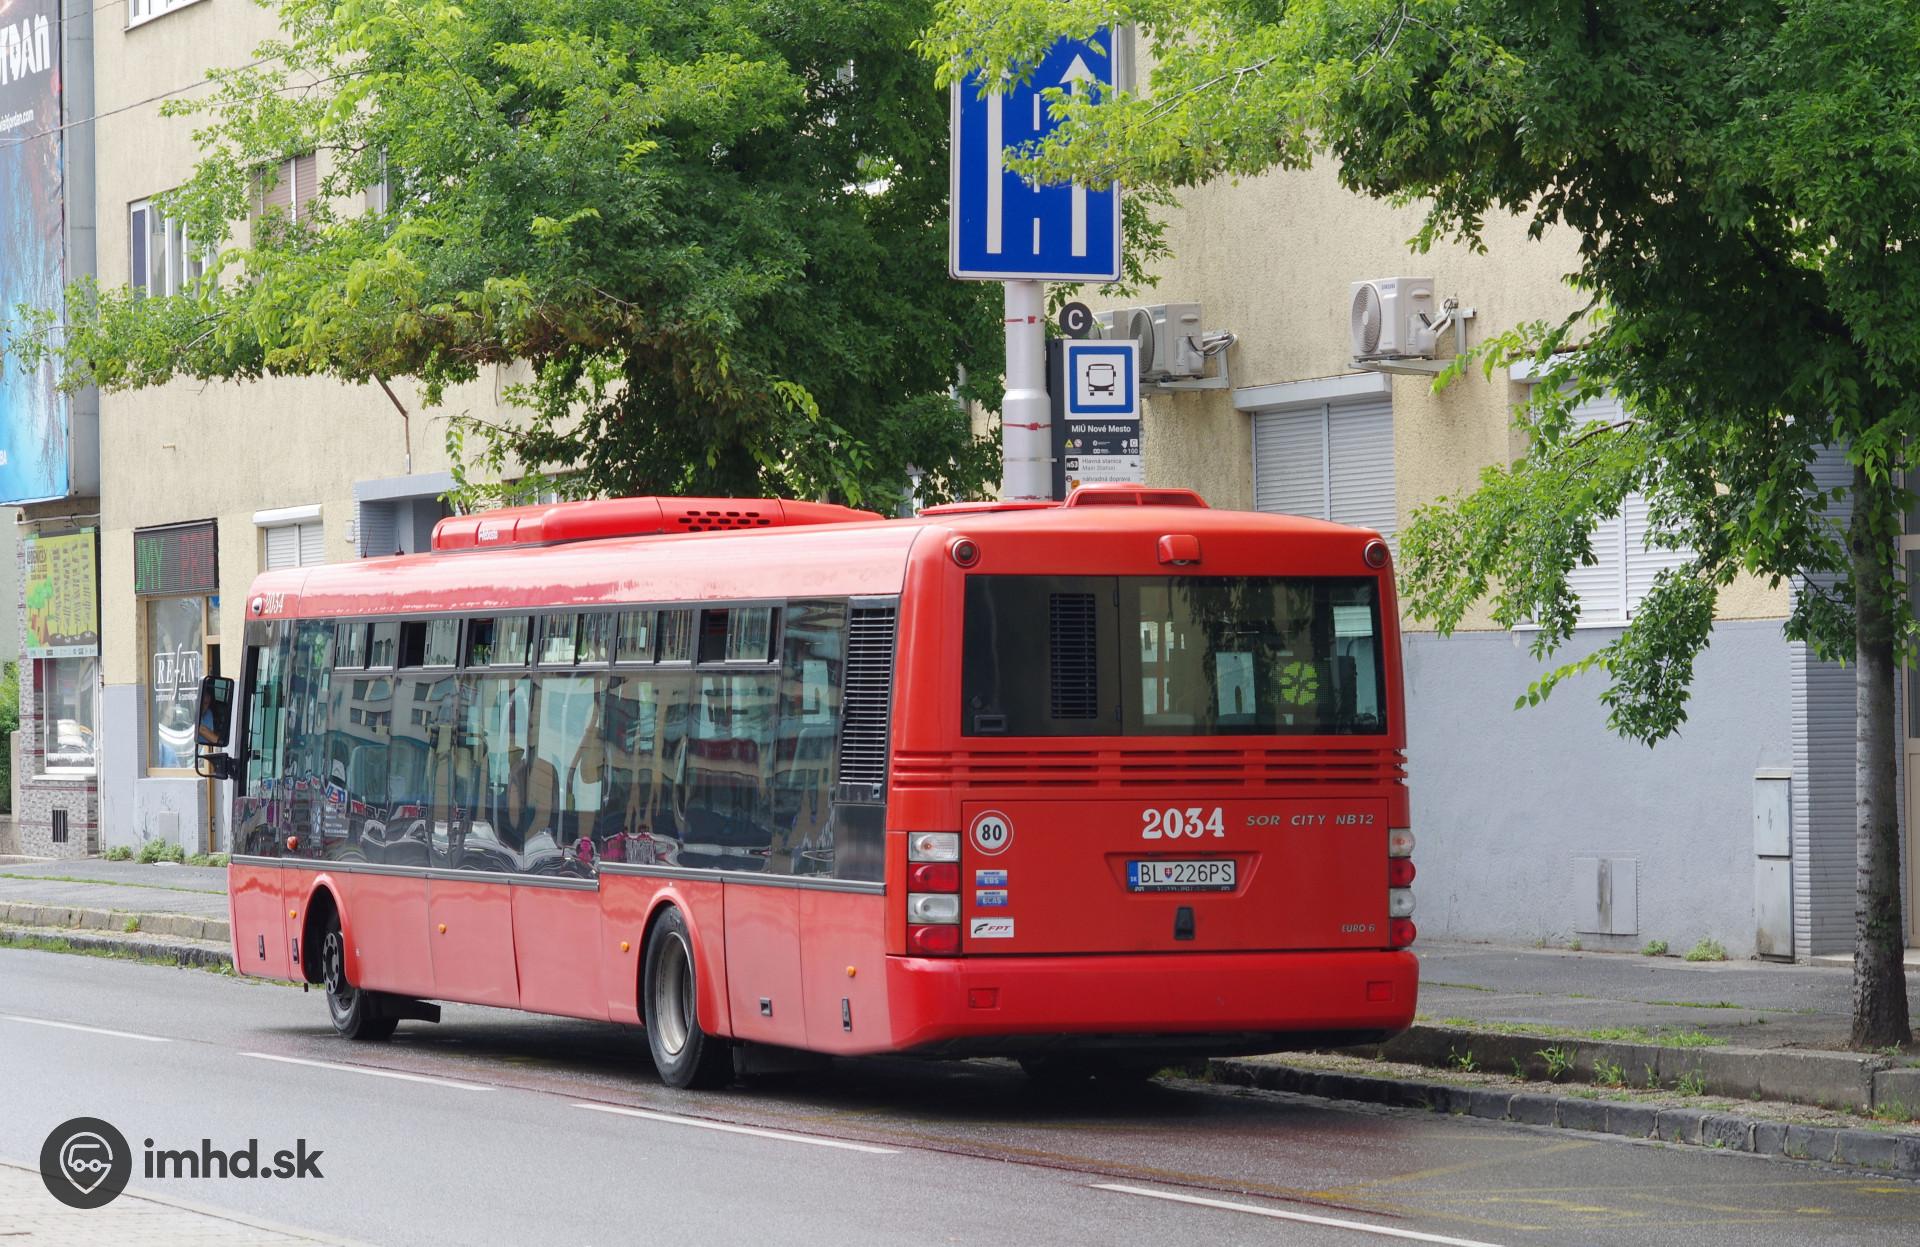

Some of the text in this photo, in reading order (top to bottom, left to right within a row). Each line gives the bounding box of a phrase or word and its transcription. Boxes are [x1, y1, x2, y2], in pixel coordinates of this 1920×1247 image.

[1068, 309, 1084, 330] C
[1087, 424, 1107, 433] Nové
[1108, 424, 1131, 433] Mesto
[264, 592, 285, 614] 2034
[1142, 807, 1224, 839] 2034
[1247, 814, 1374, 826] SOR CITY NB12
[982, 824, 1002, 841] 80
[1342, 923, 1376, 933] EURO 6
